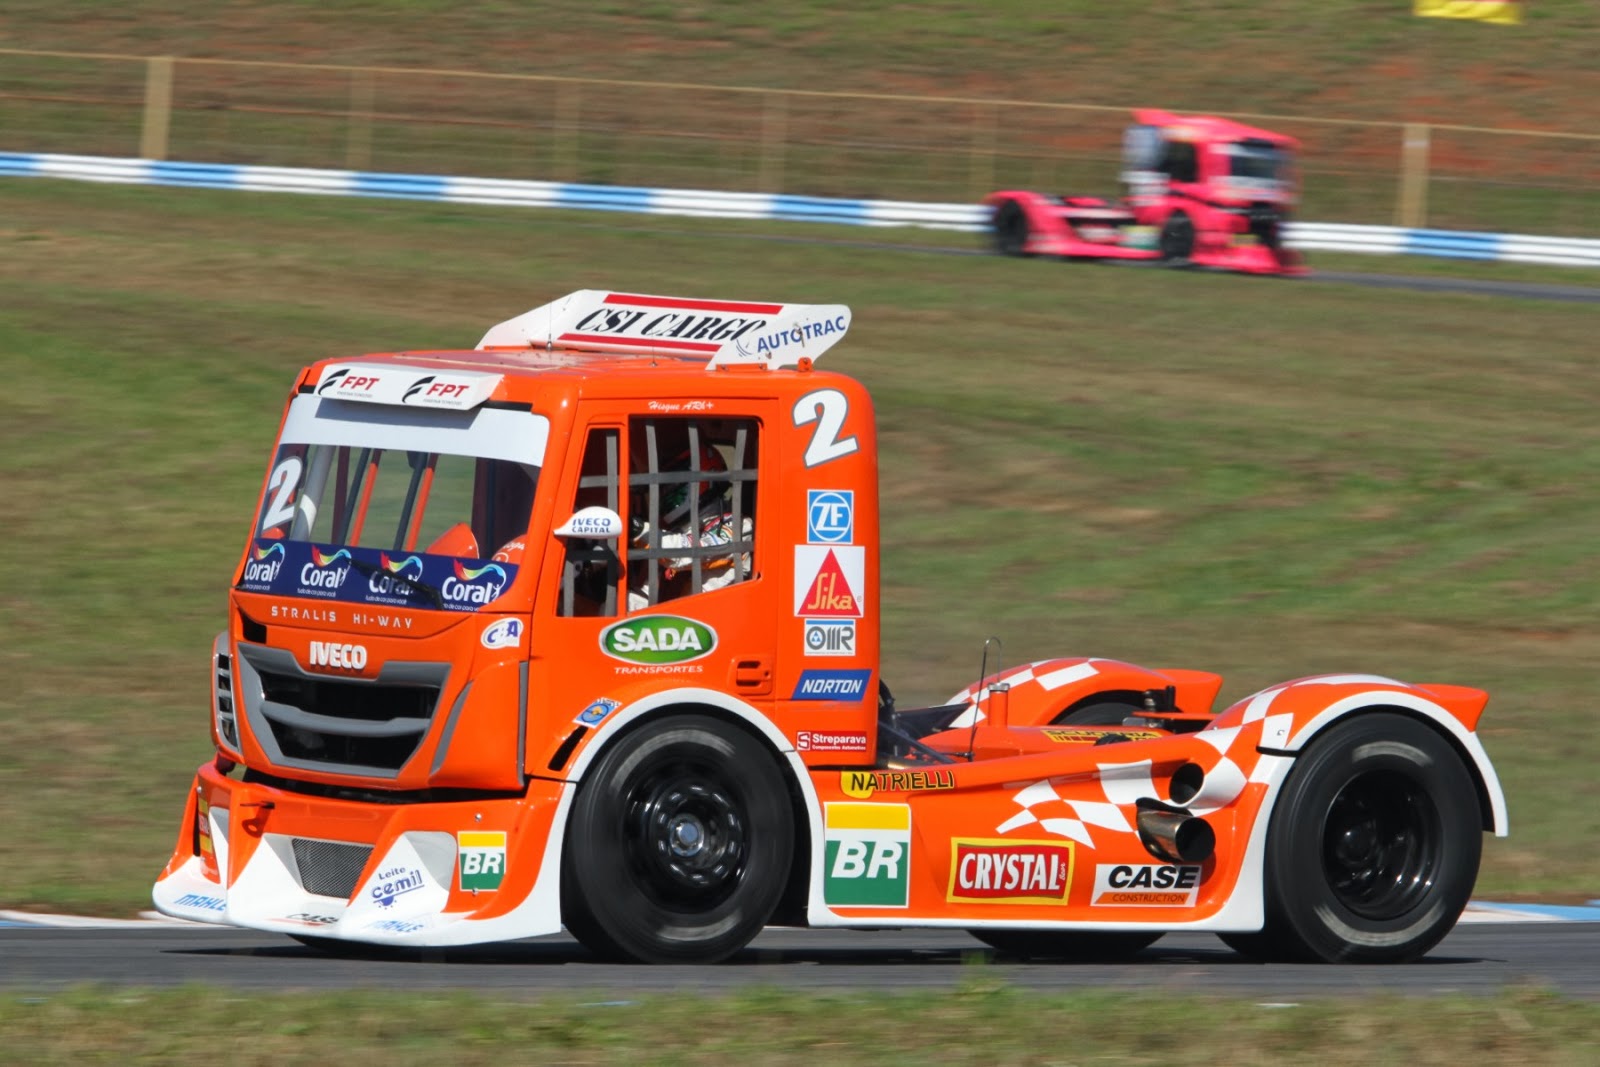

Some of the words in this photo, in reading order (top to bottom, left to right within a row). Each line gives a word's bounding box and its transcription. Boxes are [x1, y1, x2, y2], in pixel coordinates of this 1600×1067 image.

[576, 308, 645, 333] CSI
[757, 316, 846, 353] AUTOTRAC
[340, 376, 380, 391] FPT
[426, 383, 469, 398] FPT
[792, 388, 858, 468] 2
[261, 457, 303, 531] 2
[572, 517, 611, 526] IVECO
[815, 502, 845, 532] ZF
[244, 558, 276, 582] Coral
[300, 562, 342, 588] Coral
[441, 576, 493, 604] Coral
[807, 573, 852, 609] Sika
[270, 606, 337, 622] STRALIS
[352, 614, 413, 629] HI-WAY
[613, 627, 702, 652] SADA
[309, 641, 367, 669] IVECO
[614, 665, 703, 674] TRANSPORTES
[801, 679, 862, 693] NORTON
[813, 734, 866, 745] Streparava
[851, 771, 954, 791] NATRIELLI
[463, 853, 502, 875] BR
[831, 840, 903, 879] BR
[959, 853, 1060, 890] CRYSTAL
[372, 869, 423, 899] cemil
[378, 867, 406, 880] Leite
[1108, 865, 1199, 889] CASE
[1112, 894, 1185, 903] CONSTRUCTION
